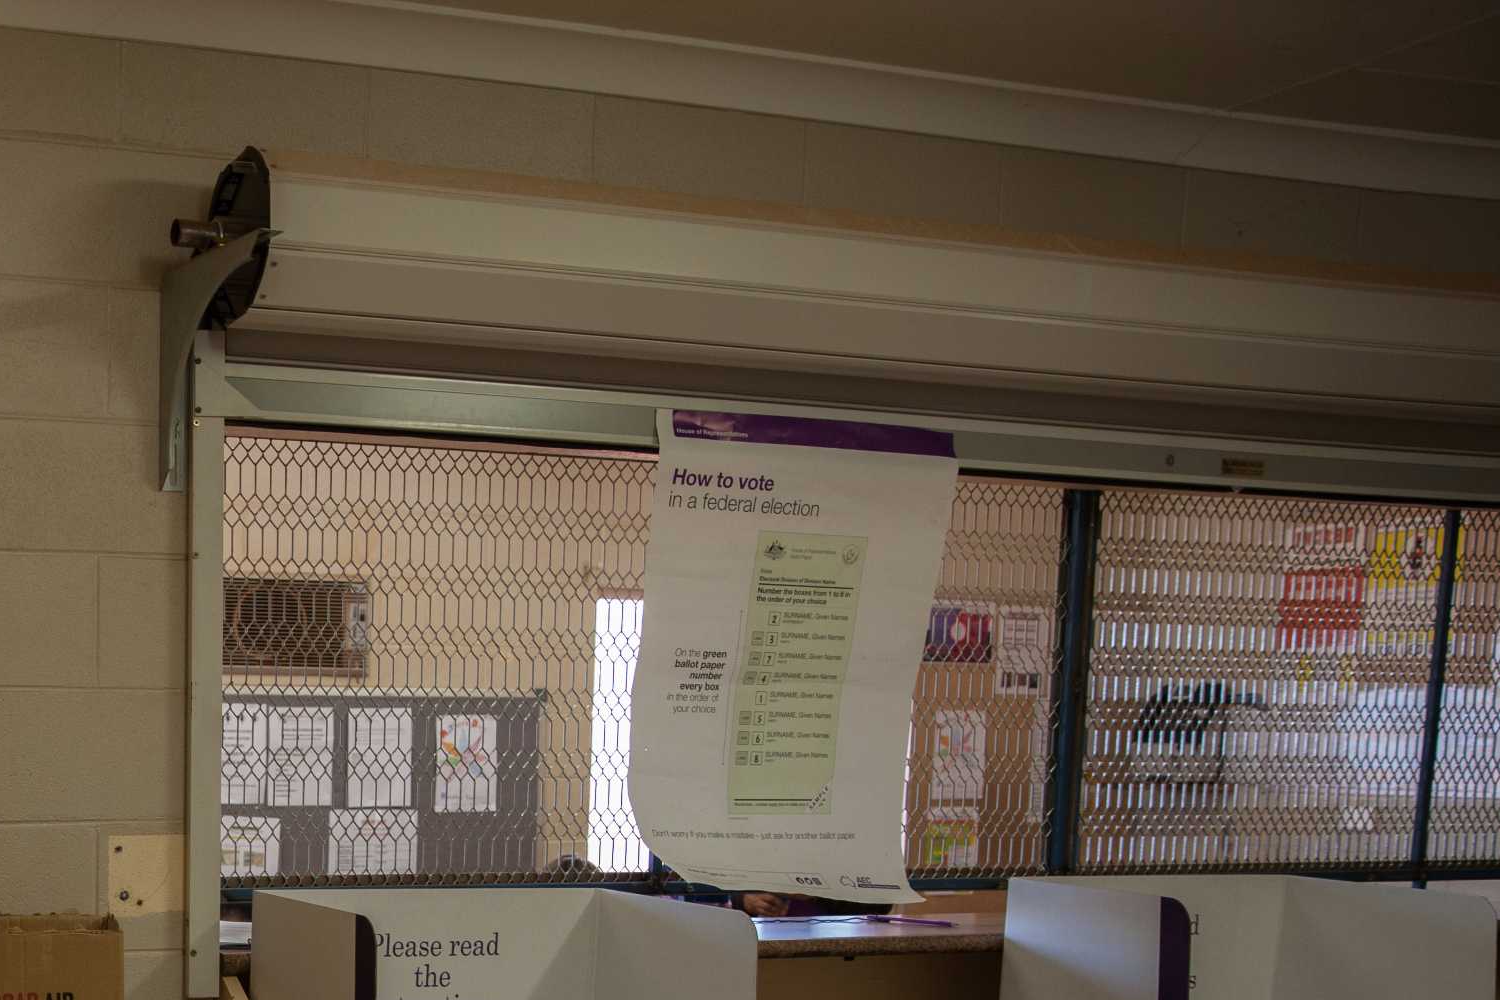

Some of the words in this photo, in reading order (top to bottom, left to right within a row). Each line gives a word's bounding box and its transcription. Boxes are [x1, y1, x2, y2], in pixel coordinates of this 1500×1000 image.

[672, 468, 713, 487] How
[717, 472, 733, 489] to
[739, 475, 775, 491] vote
[668, 491, 682, 508] in
[687, 495, 697, 509] a
[702, 493, 757, 513] federal
[761, 498, 820, 517] election
[674, 648, 687, 656] On
[703, 651, 727, 660] green
[675, 659, 699, 668] ballot
[700, 662, 725, 670] paper
[689, 672, 723, 680] number
[680, 683, 703, 692] every
[705, 682, 719, 690] box
[673, 705, 689, 714] your
[374, 933, 442, 957] Please
[449, 932, 499, 957] read
[414, 963, 451, 988] the
